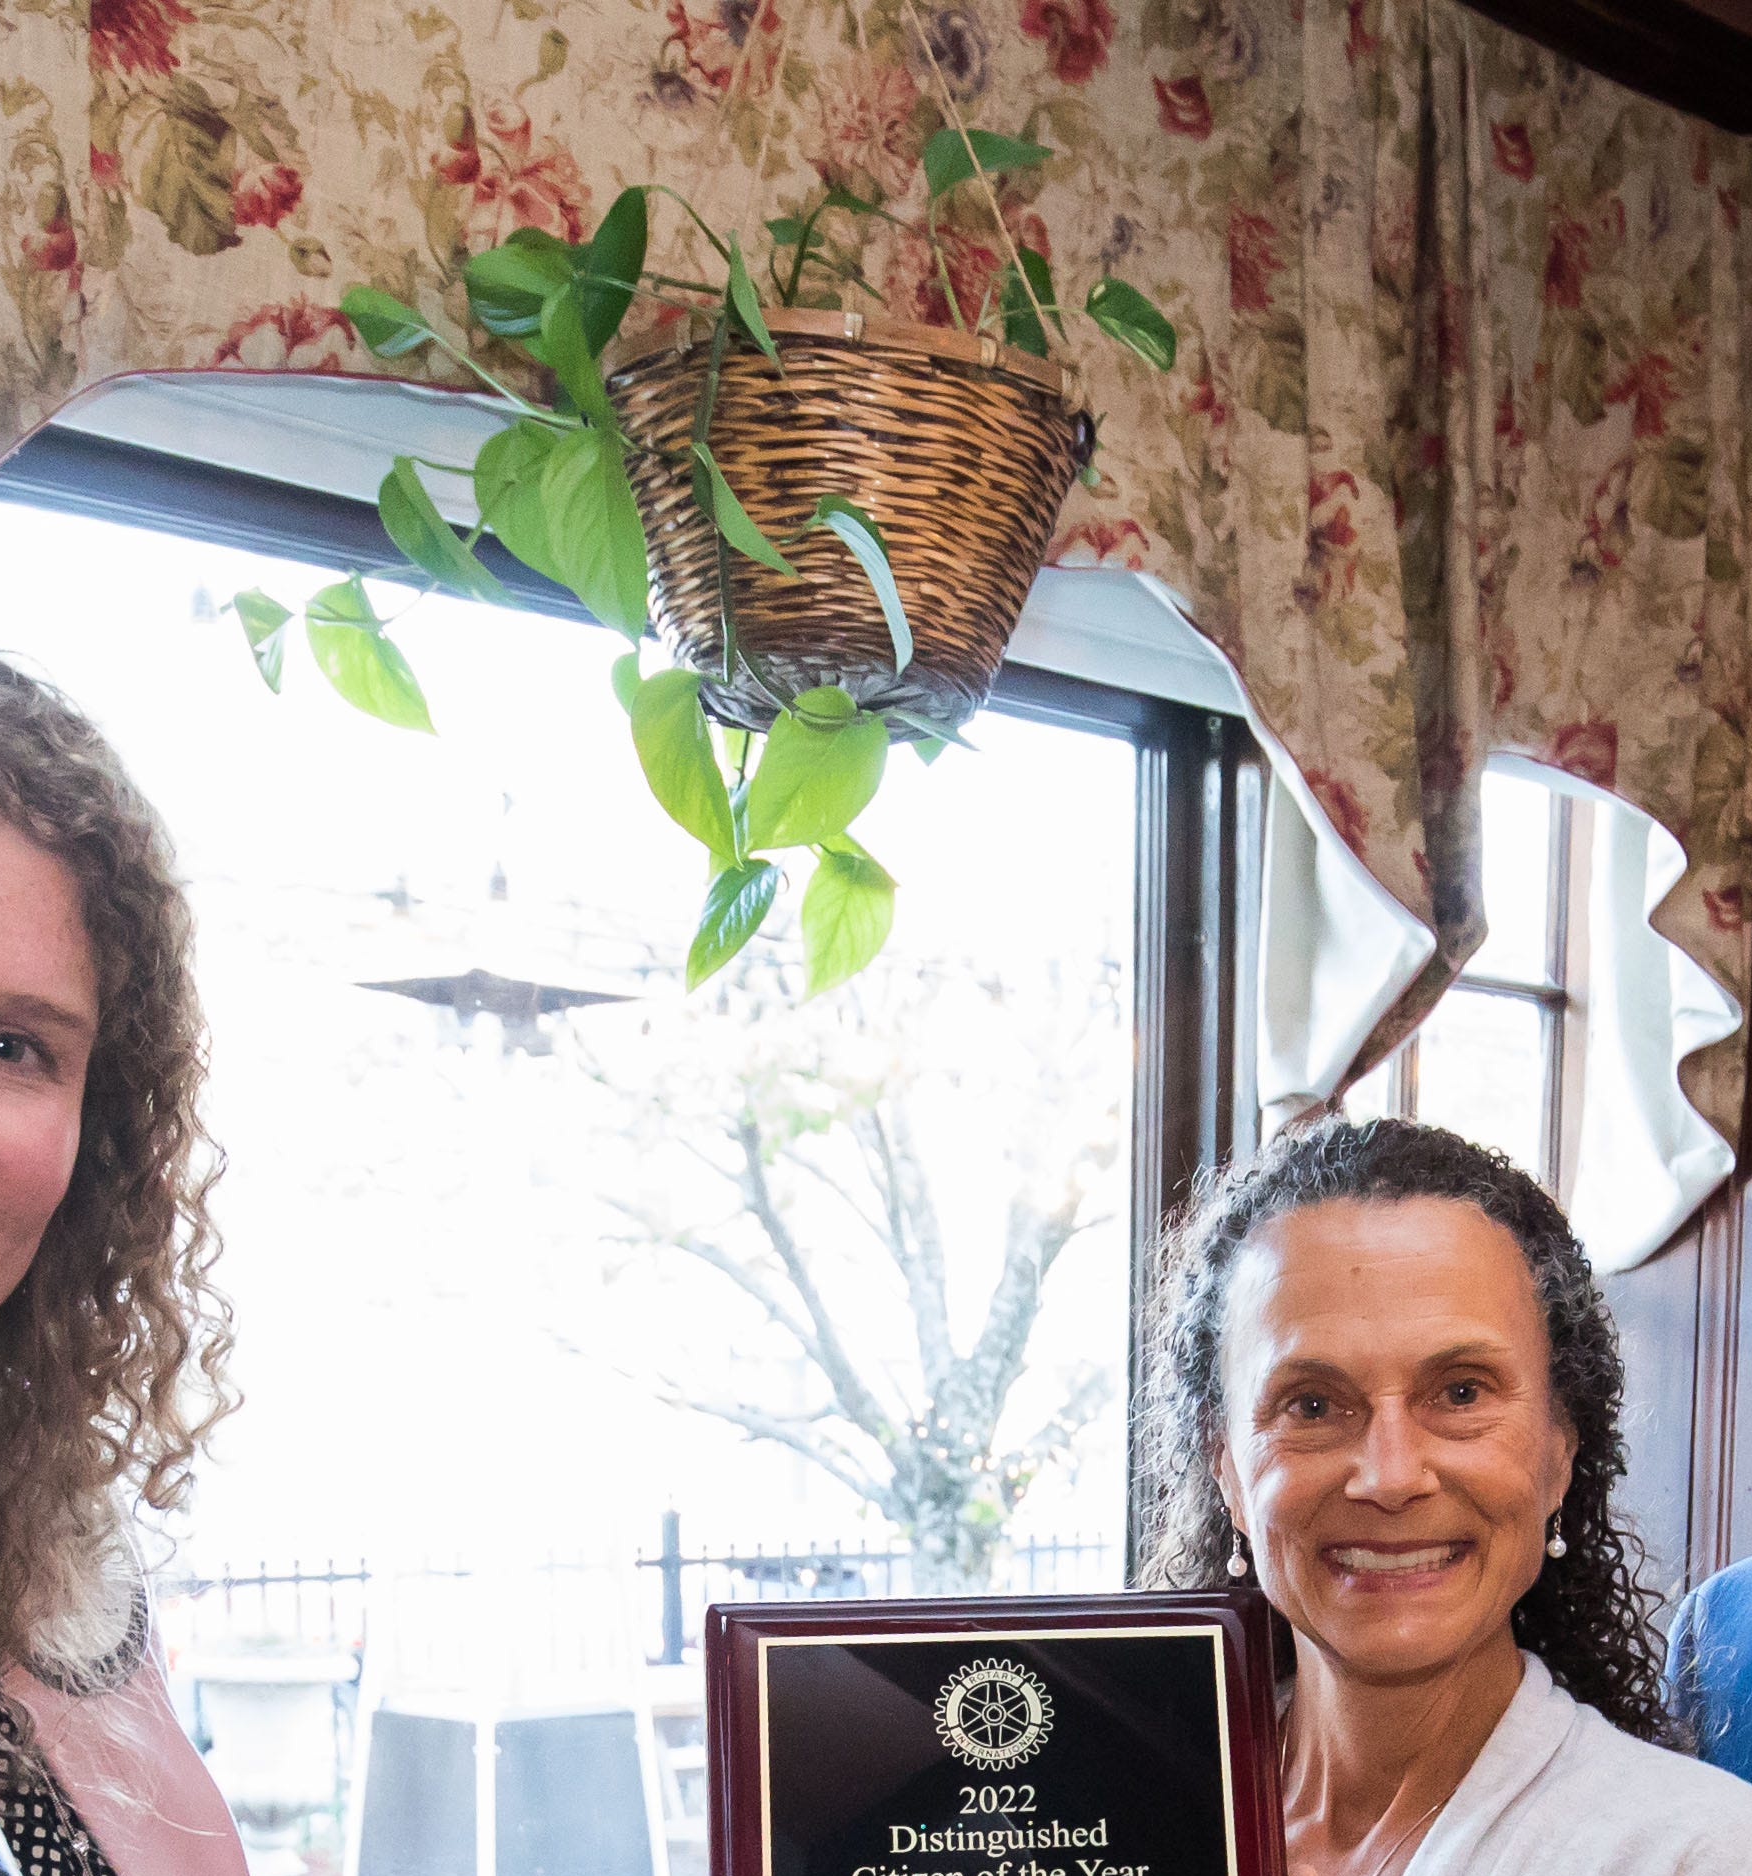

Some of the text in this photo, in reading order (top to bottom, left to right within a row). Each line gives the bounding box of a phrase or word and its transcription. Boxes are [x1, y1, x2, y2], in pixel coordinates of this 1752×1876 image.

[968, 1670, 1018, 1685] ROTARY
[954, 1728, 1037, 1758] INTERNATIONAL
[959, 1784, 1037, 1816] 2022
[888, 1817, 1109, 1859] Distinguished
